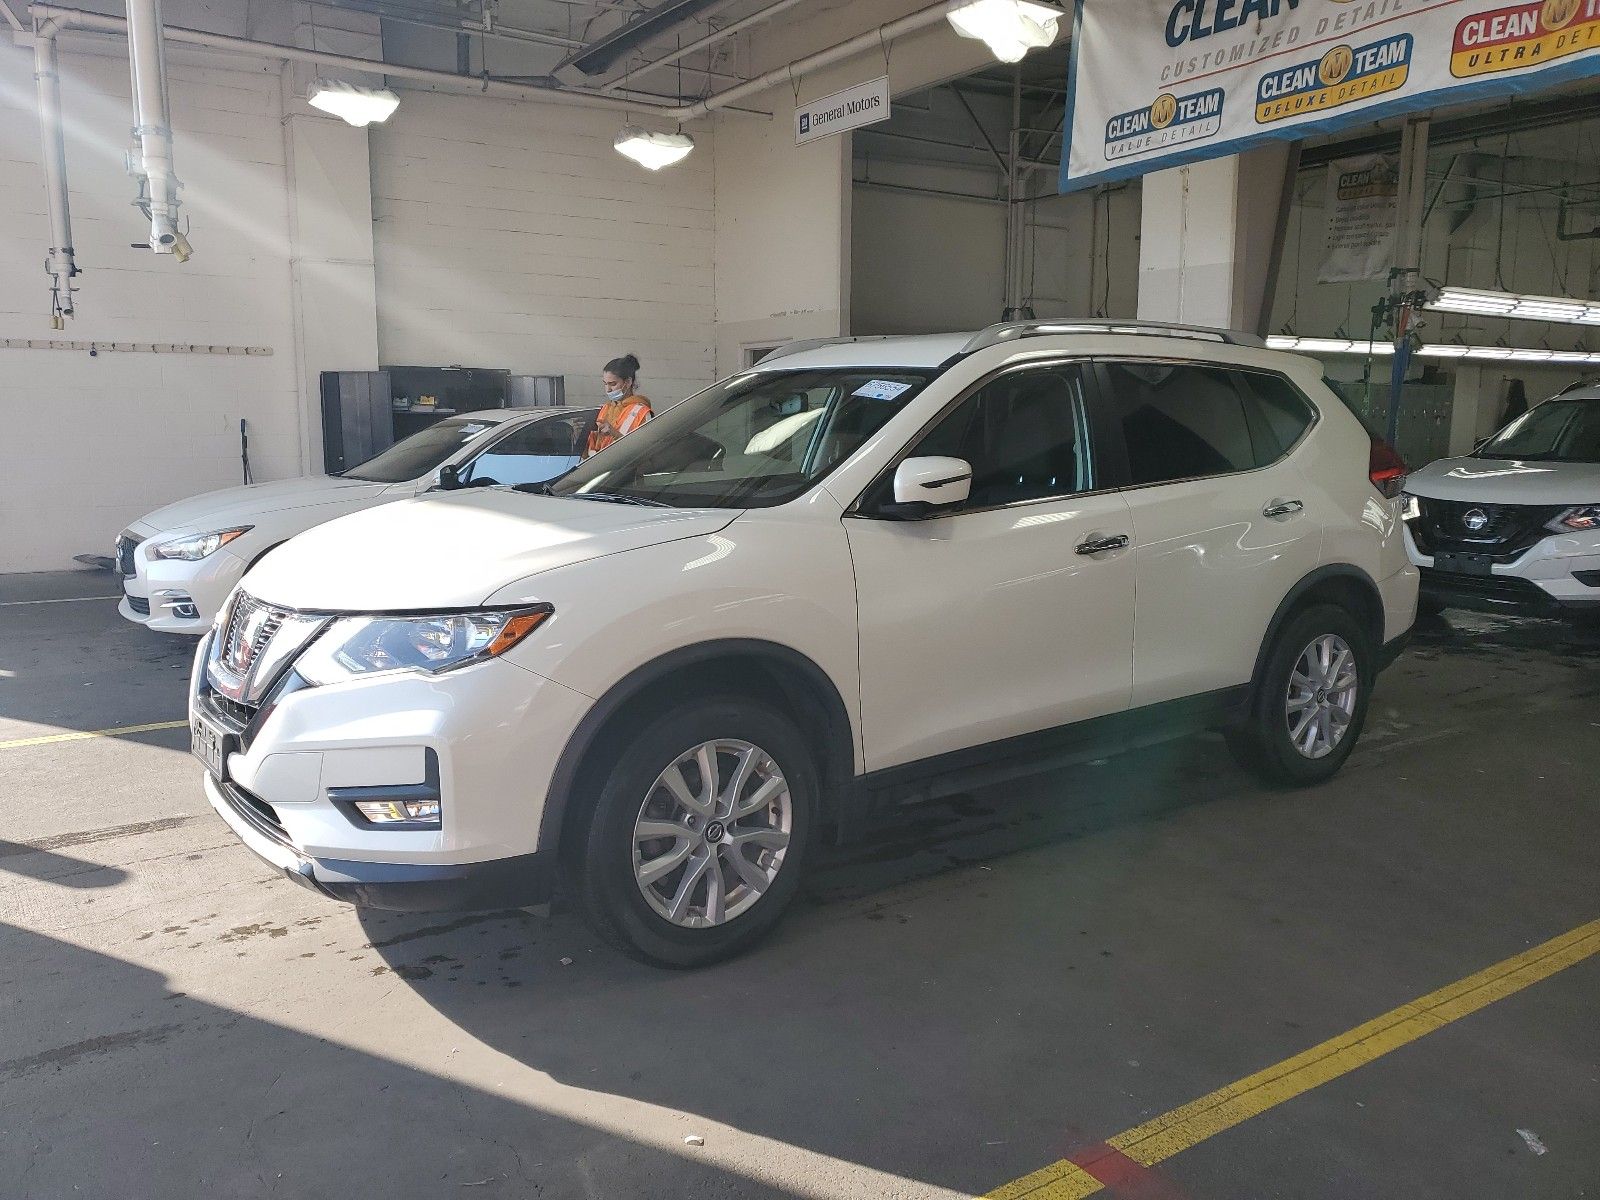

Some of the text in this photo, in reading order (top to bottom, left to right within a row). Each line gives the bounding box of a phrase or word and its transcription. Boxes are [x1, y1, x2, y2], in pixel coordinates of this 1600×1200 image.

[1161, 0, 1403, 81] CUSTOMIZED DETAIL
[1165, 0, 1299, 47] CLEA
[1462, 10, 1538, 46] CLEAN
[1261, 65, 1317, 99] CLEAN
[1355, 38, 1407, 74] TEAM
[1468, 43, 1541, 67] ULTRA
[812, 104, 845, 126] General
[847, 95, 880, 115] Motors
[1109, 111, 1150, 139] CLEAN
[1178, 92, 1220, 120] TEAM
[1264, 73, 1396, 117] DELUXE DETAIL
[1111, 122, 1212, 155] VALUE DETAIL
